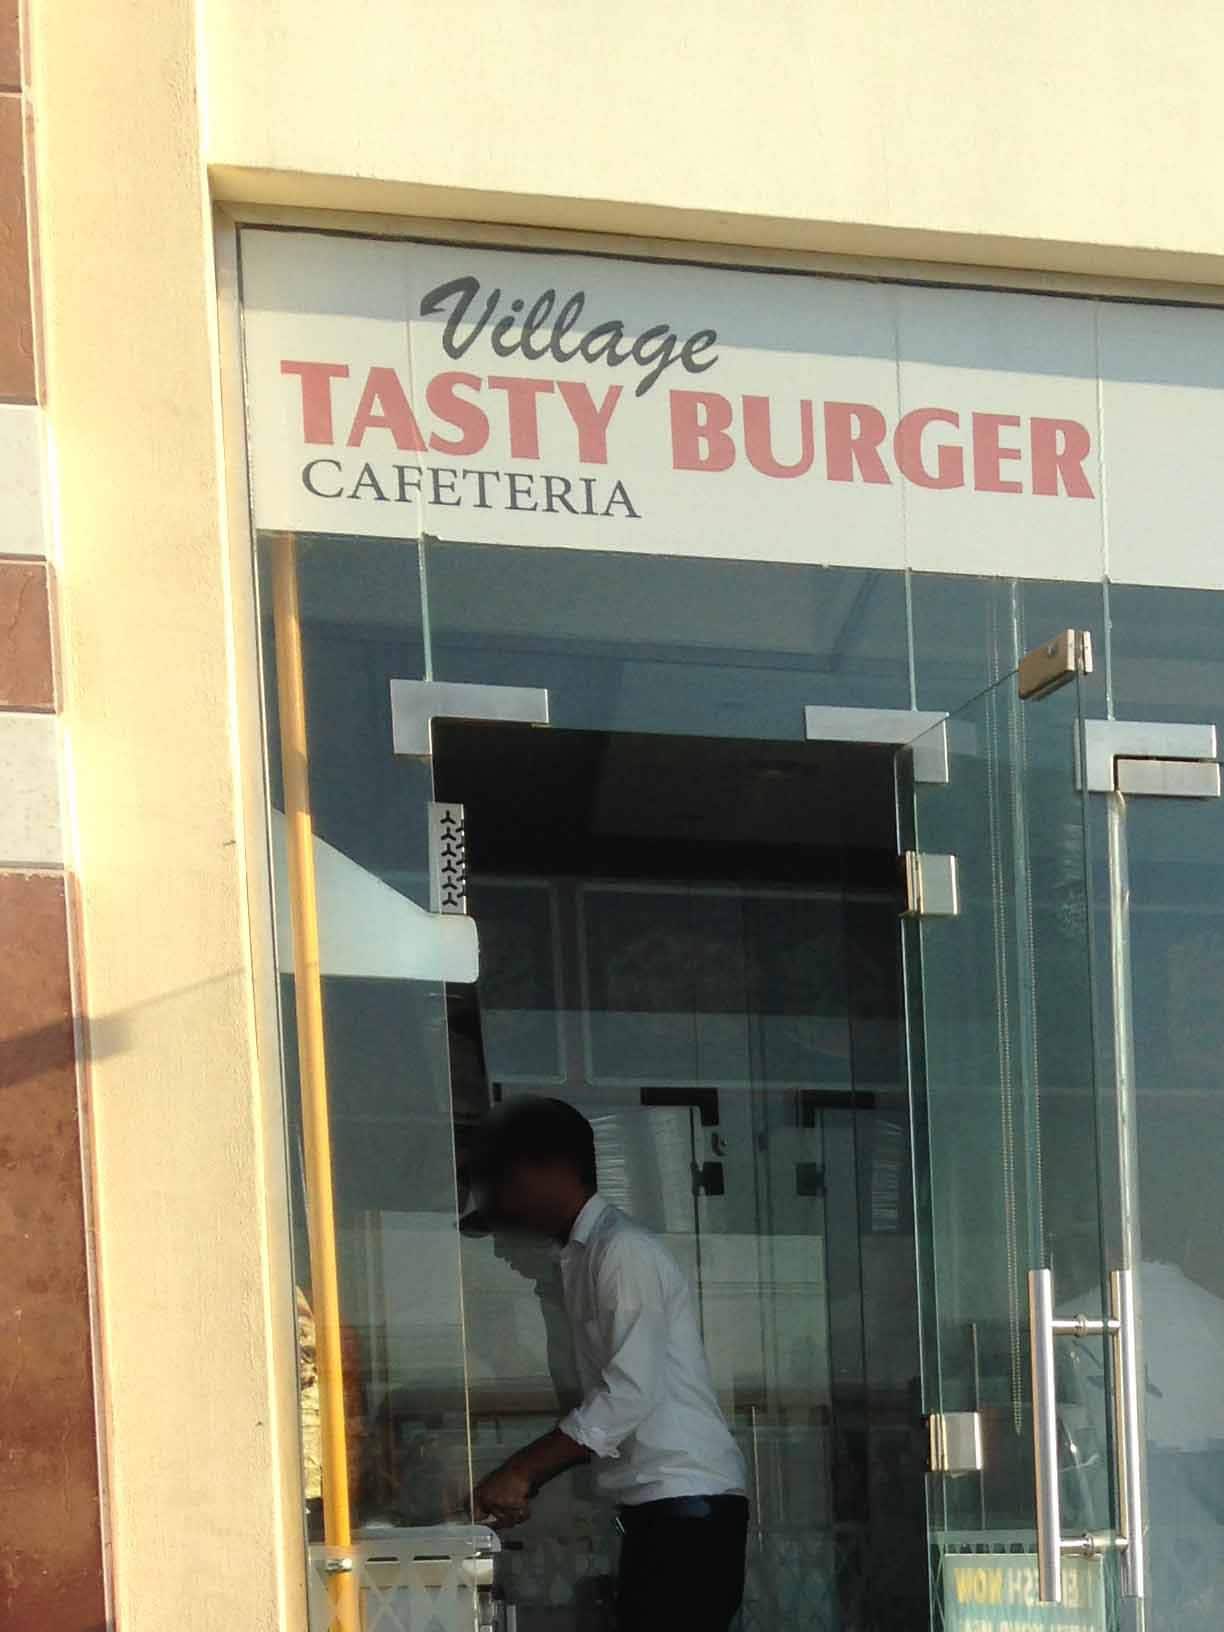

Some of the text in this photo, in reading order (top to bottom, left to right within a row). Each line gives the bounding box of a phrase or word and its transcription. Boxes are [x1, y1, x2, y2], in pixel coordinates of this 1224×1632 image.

[420, 275, 719, 397] Village
[280, 360, 1096, 498] TASTY BURGER
[301, 458, 642, 519] CAFETERIA
